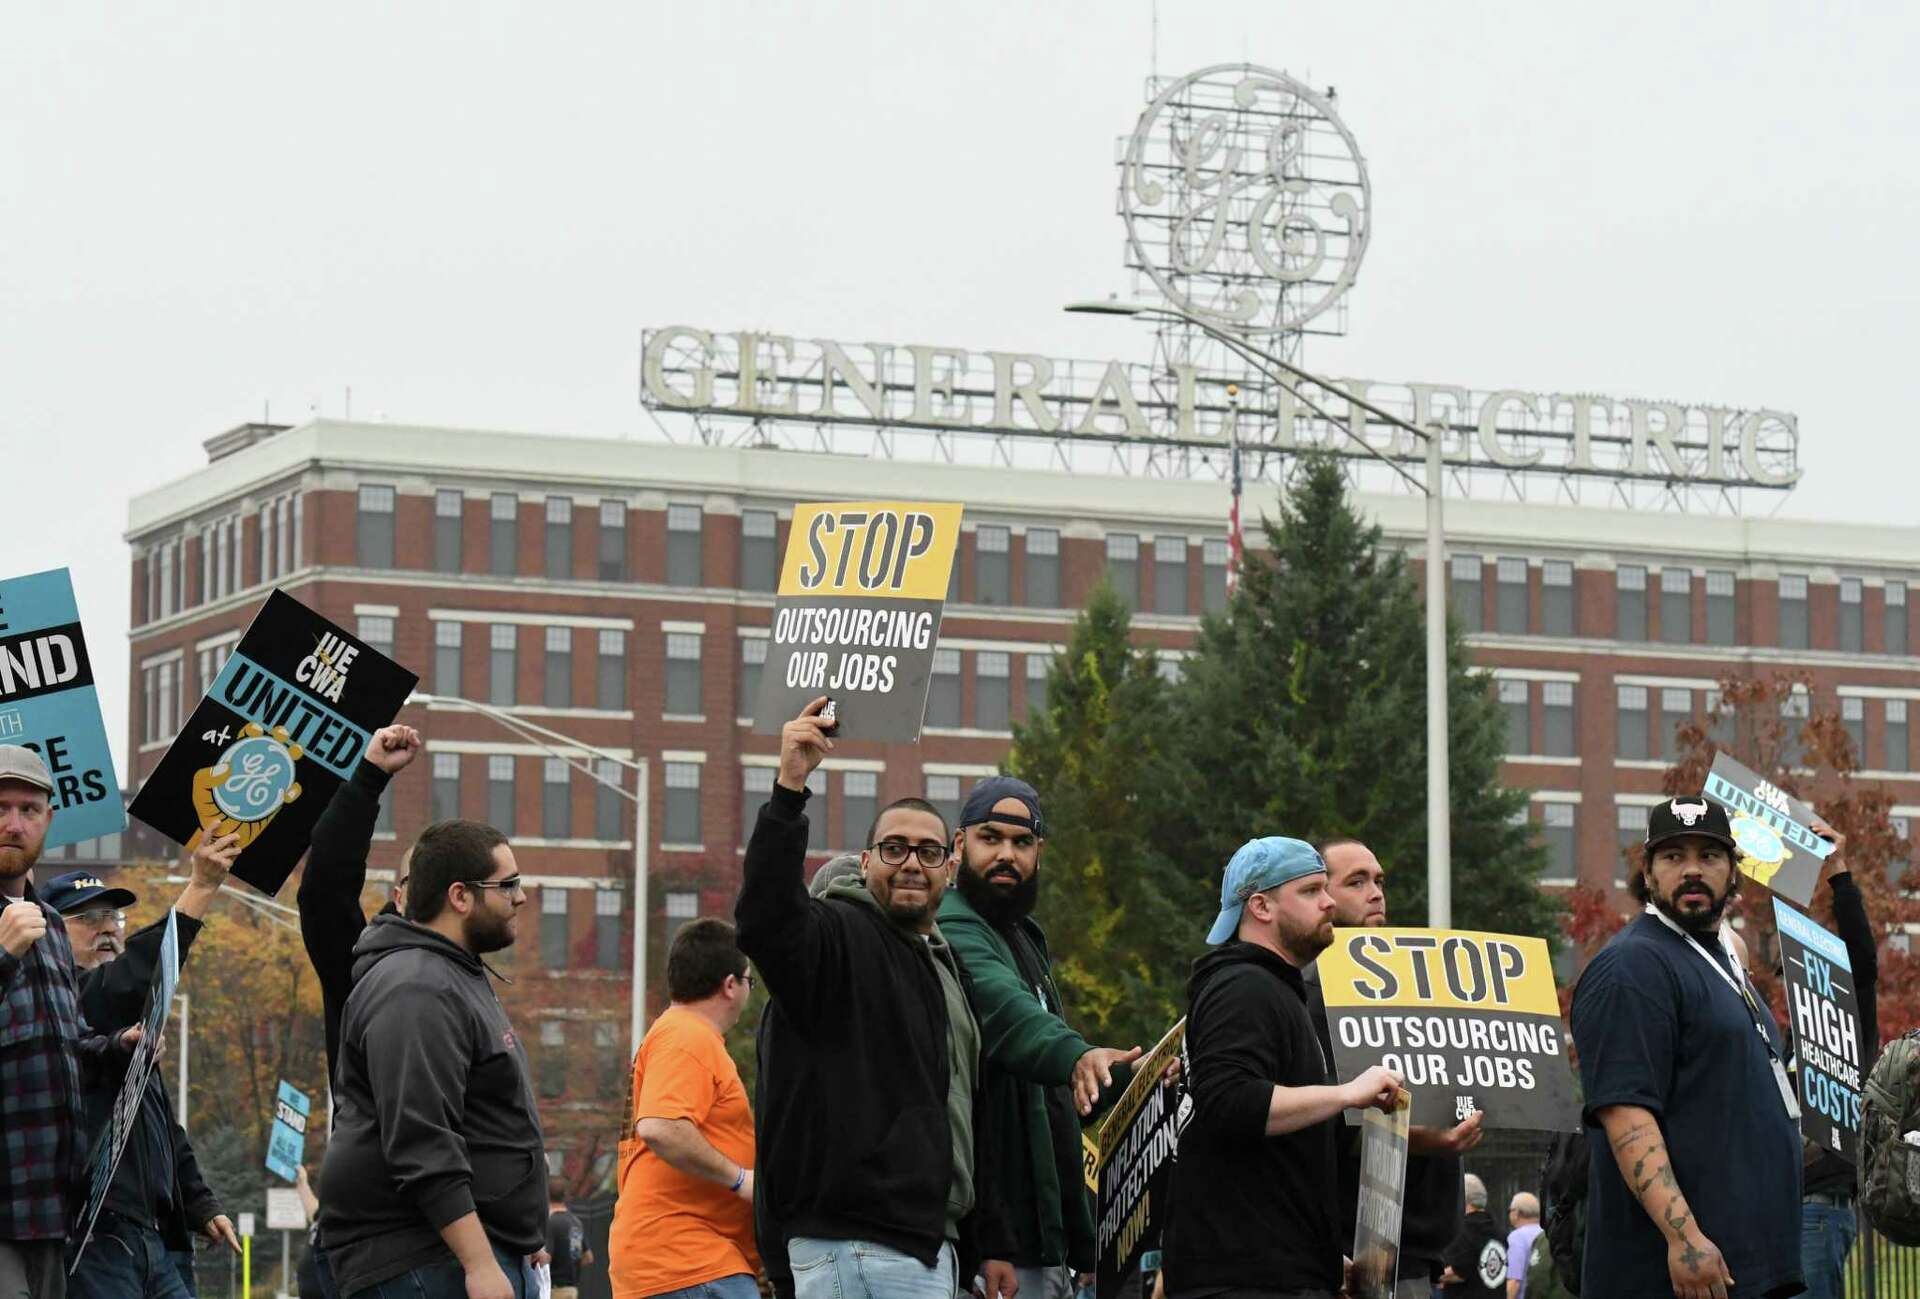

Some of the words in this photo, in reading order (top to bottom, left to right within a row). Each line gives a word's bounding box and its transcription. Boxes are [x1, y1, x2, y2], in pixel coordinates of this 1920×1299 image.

[643, 325, 1235, 443] GENERAL
[1272, 370, 1804, 486] ELECTRIC
[799, 511, 935, 591] STOP
[313, 631, 360, 675] IUE
[774, 607, 933, 651] OUTSOURCING
[295, 655, 348, 704] CWA
[785, 651, 828, 689] OUR
[829, 652, 897, 694] JOBS
[202, 725, 231, 746] at
[224, 662, 364, 770] UNITED
[1714, 779, 1820, 850] UNITED
[1347, 935, 1525, 1005] STOP
[1803, 949, 1837, 1002] FIX
[1338, 1016, 1560, 1056] OUTSOURCING
[1792, 981, 1860, 1068] HIGH
[1381, 1053, 1450, 1086] OUR
[1456, 1055, 1536, 1090] JOBS
[1801, 1038, 1861, 1092] HEALTHCARE
[1804, 1065, 1862, 1133] COSTS
[1106, 1079, 1166, 1203] INFLATION
[1117, 1189, 1150, 1273] NOW!
